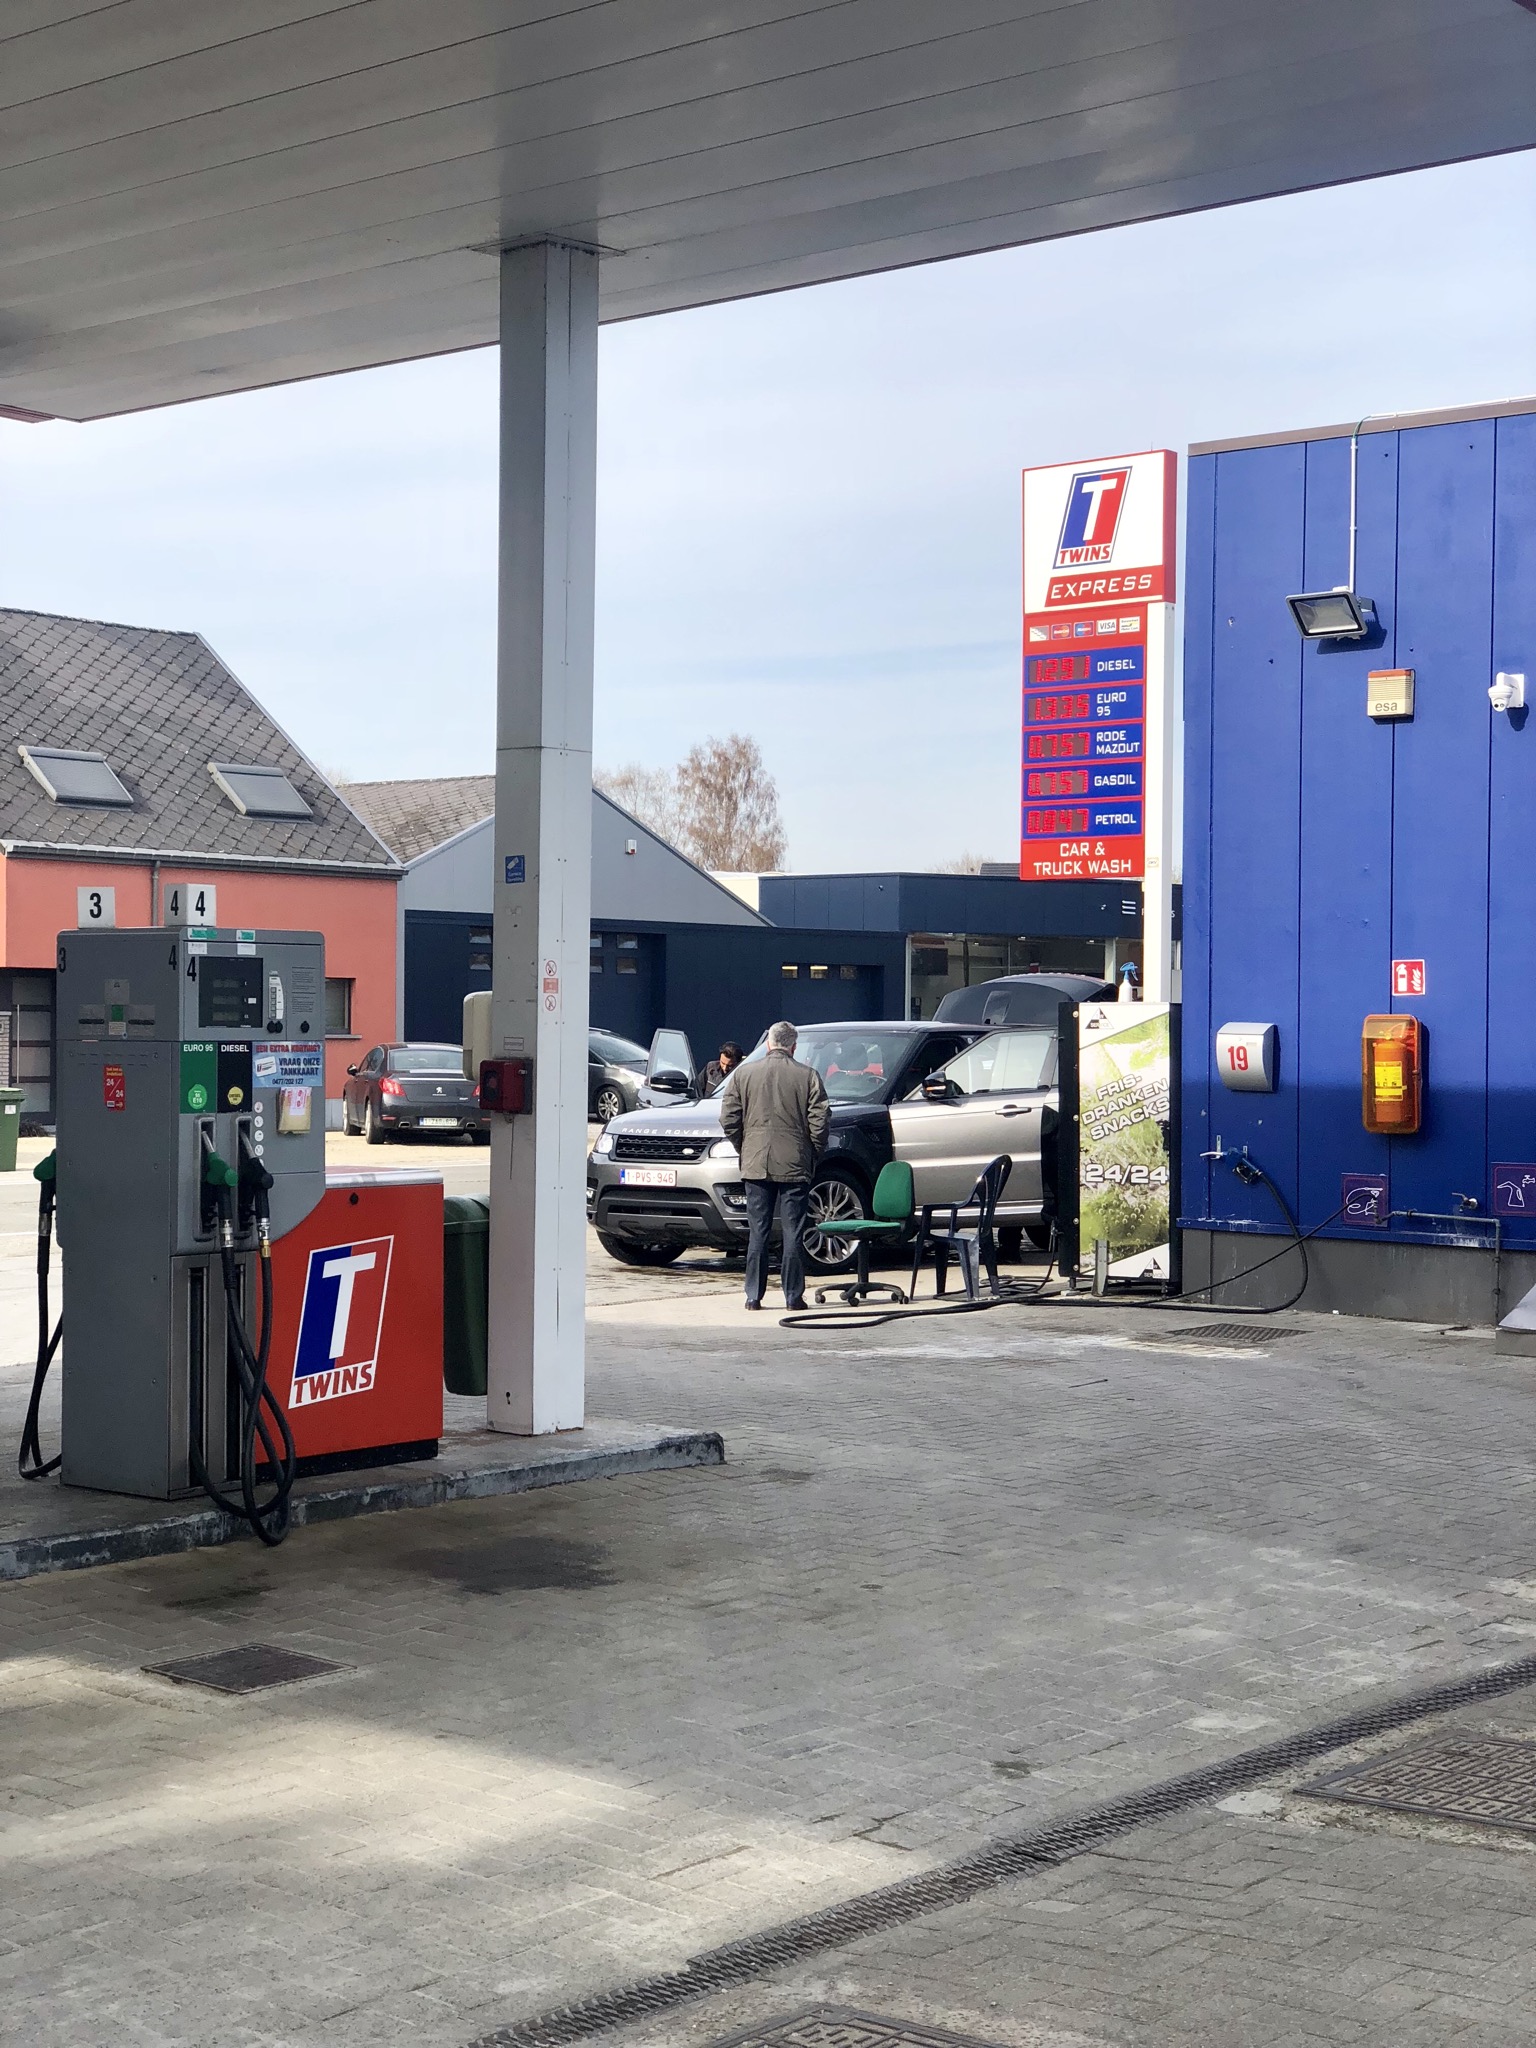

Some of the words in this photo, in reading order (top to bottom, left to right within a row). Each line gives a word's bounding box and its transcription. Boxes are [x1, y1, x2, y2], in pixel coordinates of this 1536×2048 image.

[1081, 478, 1117, 540] T
[1059, 545, 1111, 565] TWINS
[1050, 573, 1153, 599] EXPRESS
[1099, 621, 1116, 630] VISA
[1097, 659, 1136, 672] DIESEL
[1096, 691, 1127, 704] EURO
[1096, 706, 1111, 717] 95
[1375, 702, 1398, 712] esa
[1096, 731, 1127, 742] RODE
[1096, 742, 1140, 755] MAZOUT
[1094, 774, 1136, 786] GASOIL
[1095, 813, 1137, 825] PETROL
[1059, 842, 1089, 857] CAR
[1094, 841, 1106, 856] &
[1033, 861, 1083, 876] TRUCK
[1088, 858, 1132, 874] WASH
[89, 893, 102, 919] 3
[170, 890, 179, 916] 4
[195, 890, 206, 917] 4
[58, 947, 66, 973] 3
[168, 945, 177, 970] 4
[187, 957, 197, 982] 4
[183, 1044, 203, 1052] EURO
[205, 1044, 213, 1052] 95
[221, 1044, 249, 1052] DIESEL
[270, 1044, 289, 1053] EXTRA
[279, 1057, 301, 1066] VRAAG
[302, 1057, 320, 1066] ONZE
[1227, 1045, 1249, 1071] 19
[280, 1067, 318, 1076] TANKKAART
[1096, 1073, 1143, 1101] FRIS-
[1082, 1078, 1169, 1126] DRANKEN
[1090, 1096, 1170, 1141] SNACKS
[621, 1127, 658, 1135] RANGE
[1085, 1163, 1169, 1186] 24/24
[322, 1252, 377, 1359] T
[294, 1363, 373, 1404] TWINS
